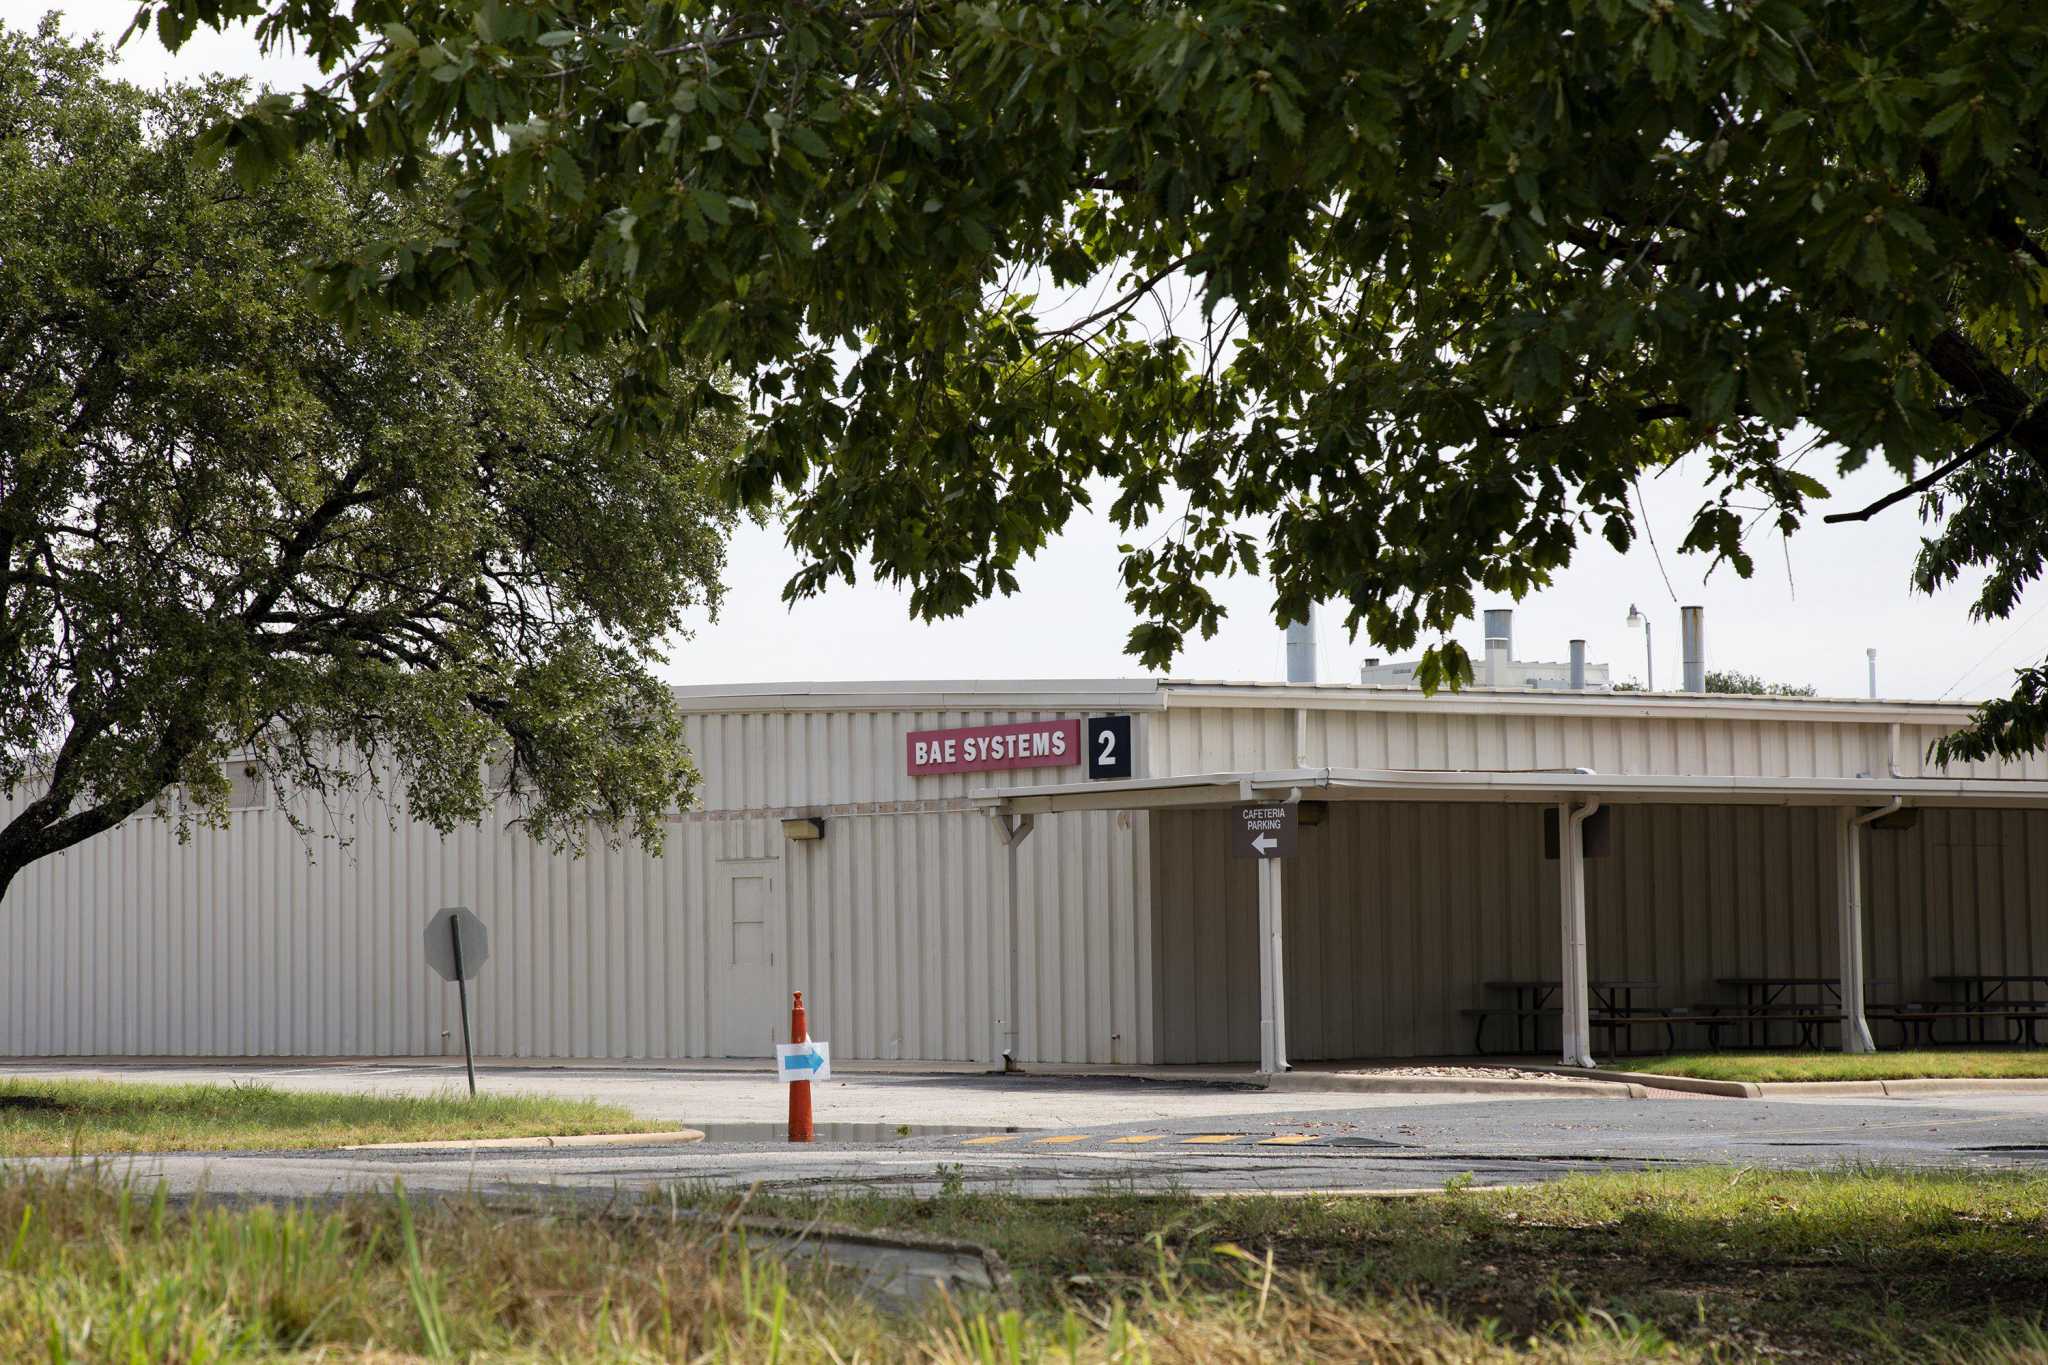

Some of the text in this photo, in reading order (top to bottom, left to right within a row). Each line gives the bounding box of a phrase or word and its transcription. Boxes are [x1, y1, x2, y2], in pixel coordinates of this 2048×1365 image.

[915, 731, 1066, 765] BAE SYSTEMS
[1097, 730, 1116, 766] 2
[1242, 808, 1285, 819] CAFETERIA
[1247, 819, 1281, 830] PARKING
